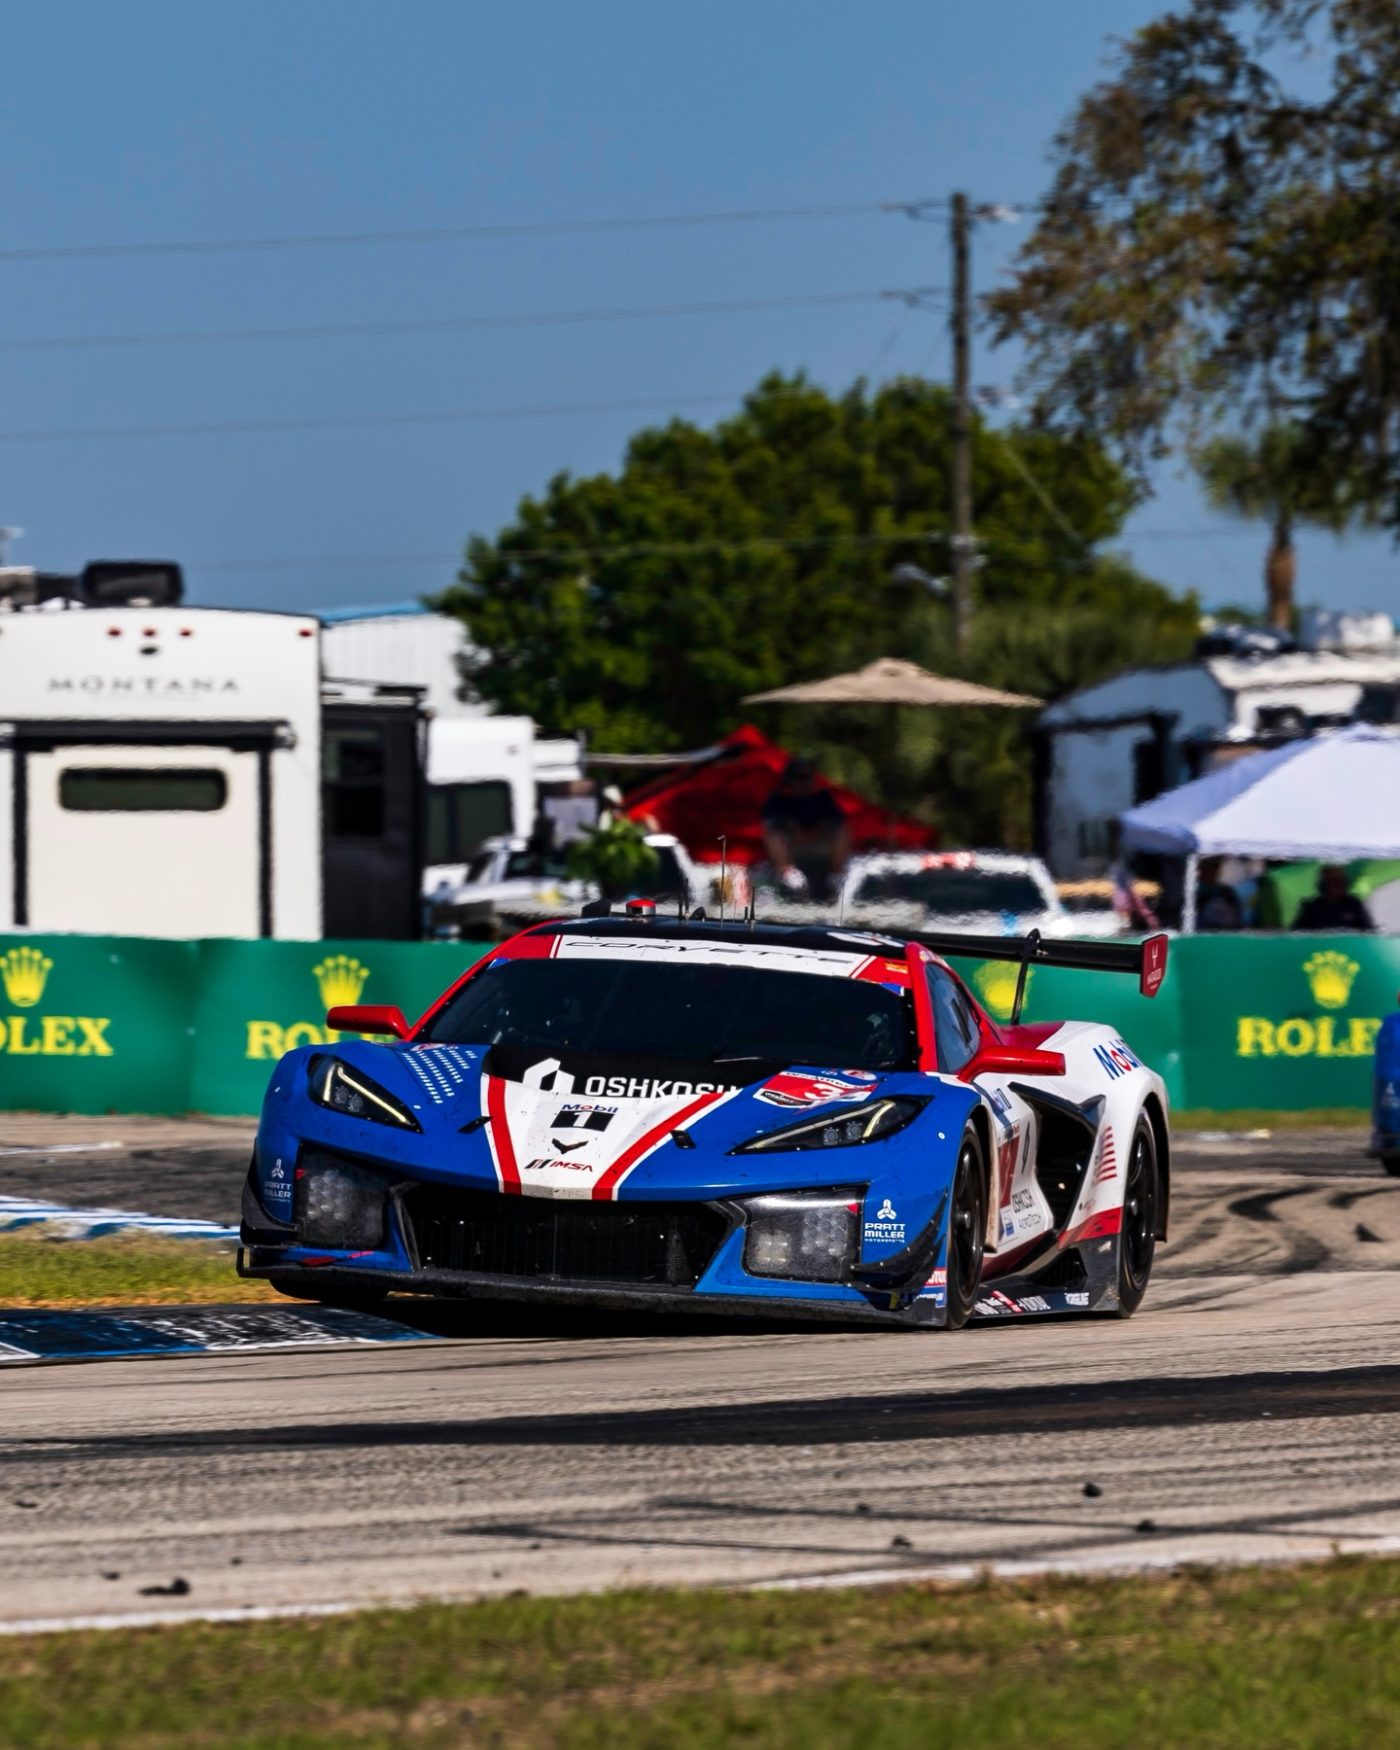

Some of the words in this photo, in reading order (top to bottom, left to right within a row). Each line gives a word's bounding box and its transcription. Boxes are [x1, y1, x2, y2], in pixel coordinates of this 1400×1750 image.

[48, 674, 241, 693] MONTANA
[565, 941, 853, 964] CORVETTE
[0, 1016, 114, 1056] LEX
[1236, 1016, 1384, 1057] ROLE
[562, 1103, 619, 1114] Mobil
[572, 1111, 593, 1128] 1
[550, 1160, 593, 1173] IMSA
[864, 1222, 906, 1231] PRATT
[864, 1230, 905, 1239] MILLER
